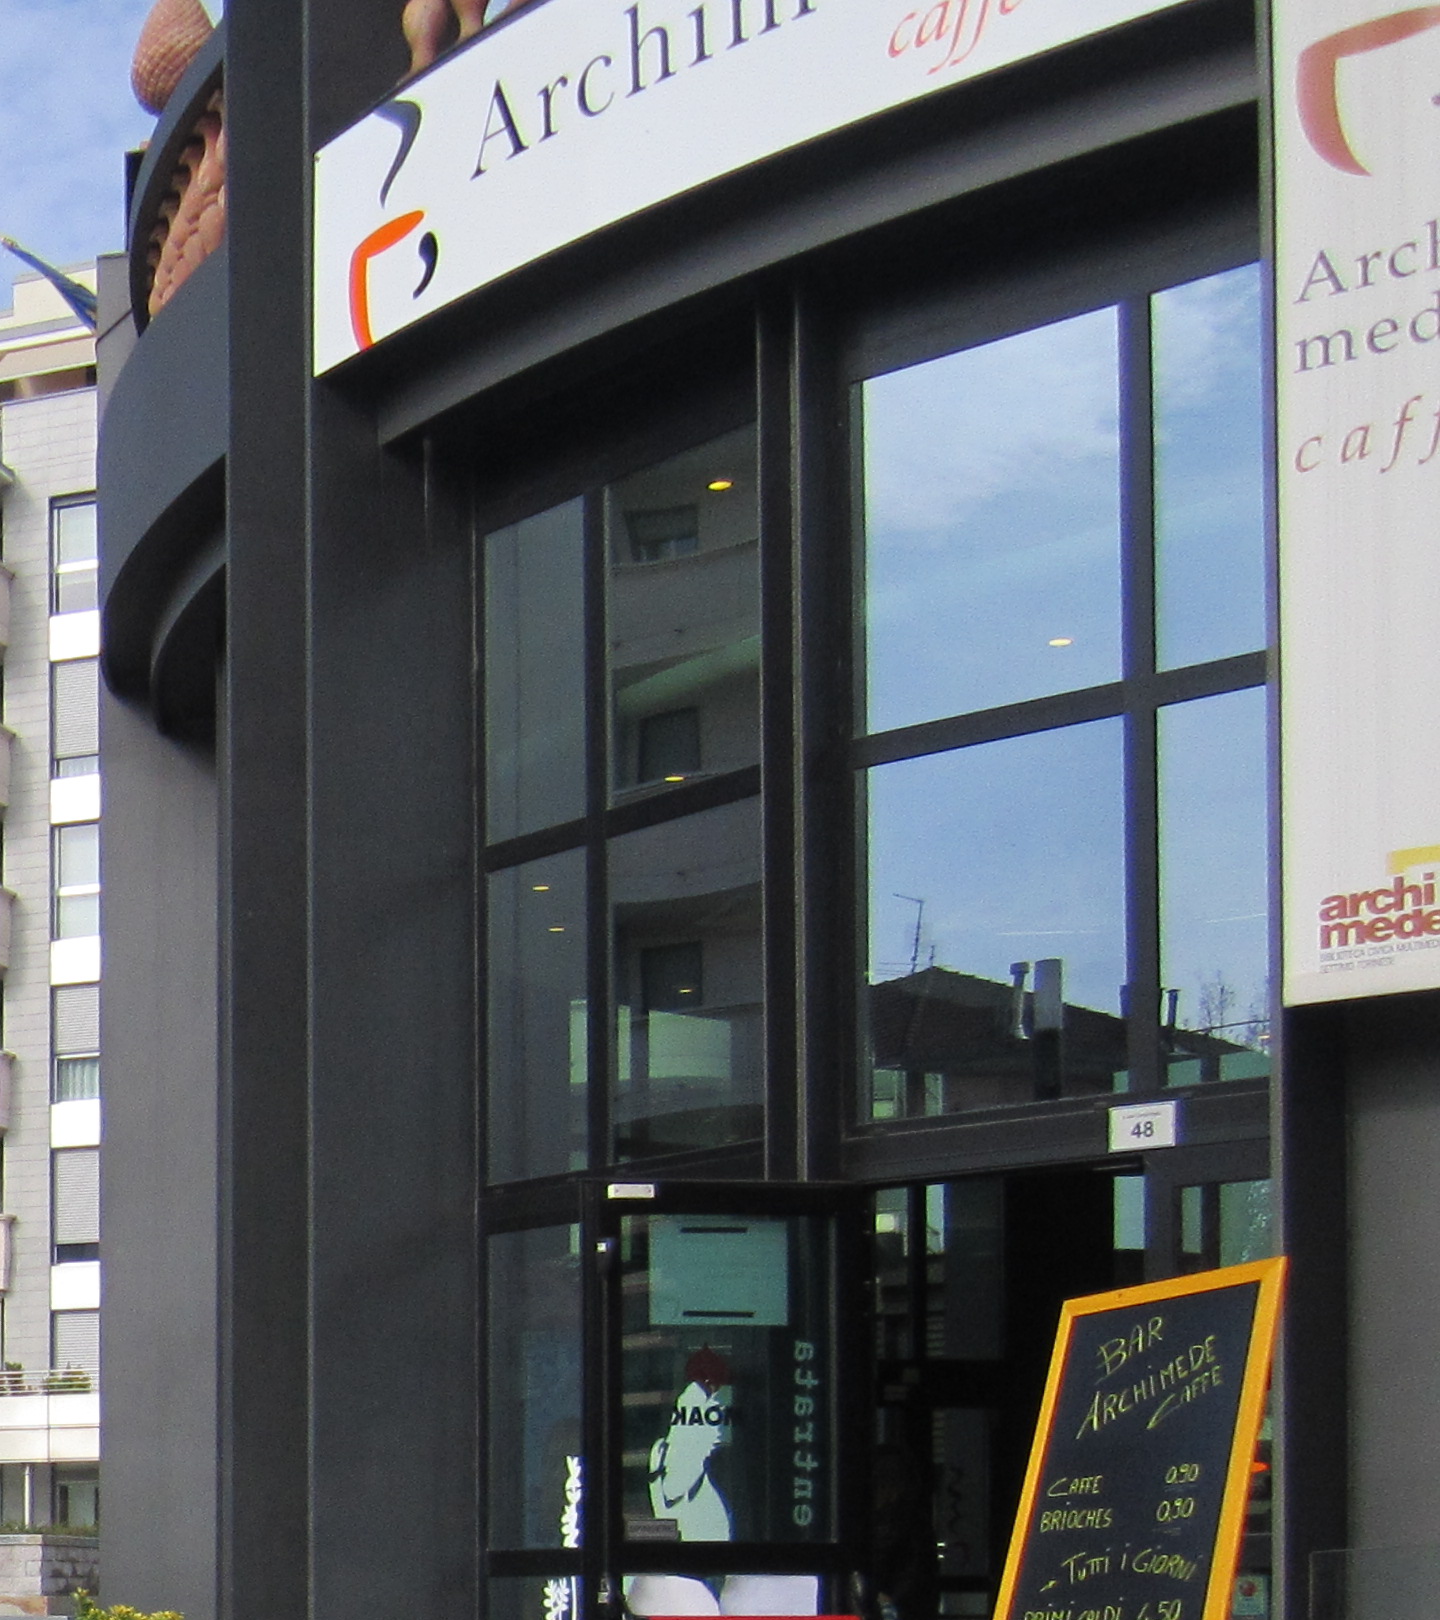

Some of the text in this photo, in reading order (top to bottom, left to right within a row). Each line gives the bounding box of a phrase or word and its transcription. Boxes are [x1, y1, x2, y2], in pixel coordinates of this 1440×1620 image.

[1320, 872, 1435, 922] archi
[1131, 1121, 1154, 1139] 48
[1095, 1316, 1163, 1385] BAR
[1040, 1502, 1114, 1533] BRIOCHES
